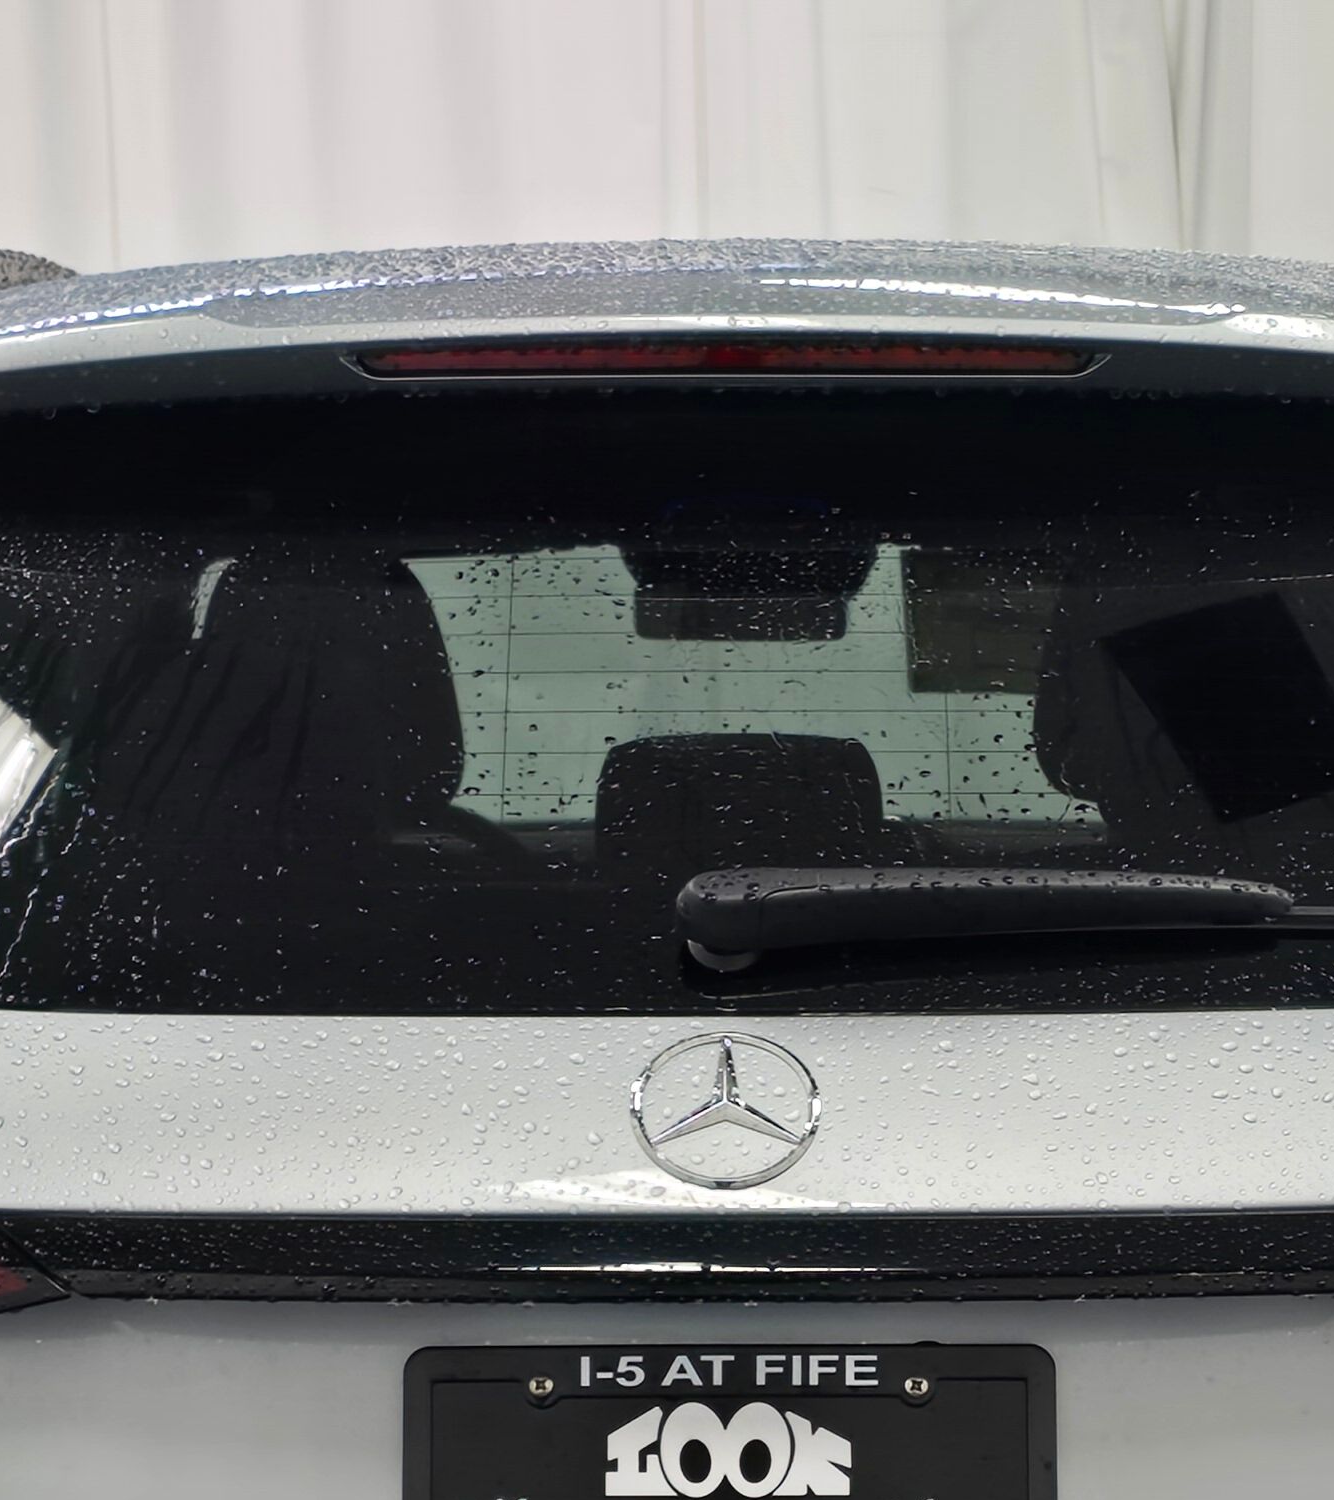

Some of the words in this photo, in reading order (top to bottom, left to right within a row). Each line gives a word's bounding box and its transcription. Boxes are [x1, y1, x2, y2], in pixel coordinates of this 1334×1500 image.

[579, 1355, 646, 1387] I-5
[661, 1355, 735, 1387] AT
[756, 1354, 880, 1386] FIFE
[604, 1401, 853, 1498] LOOK
